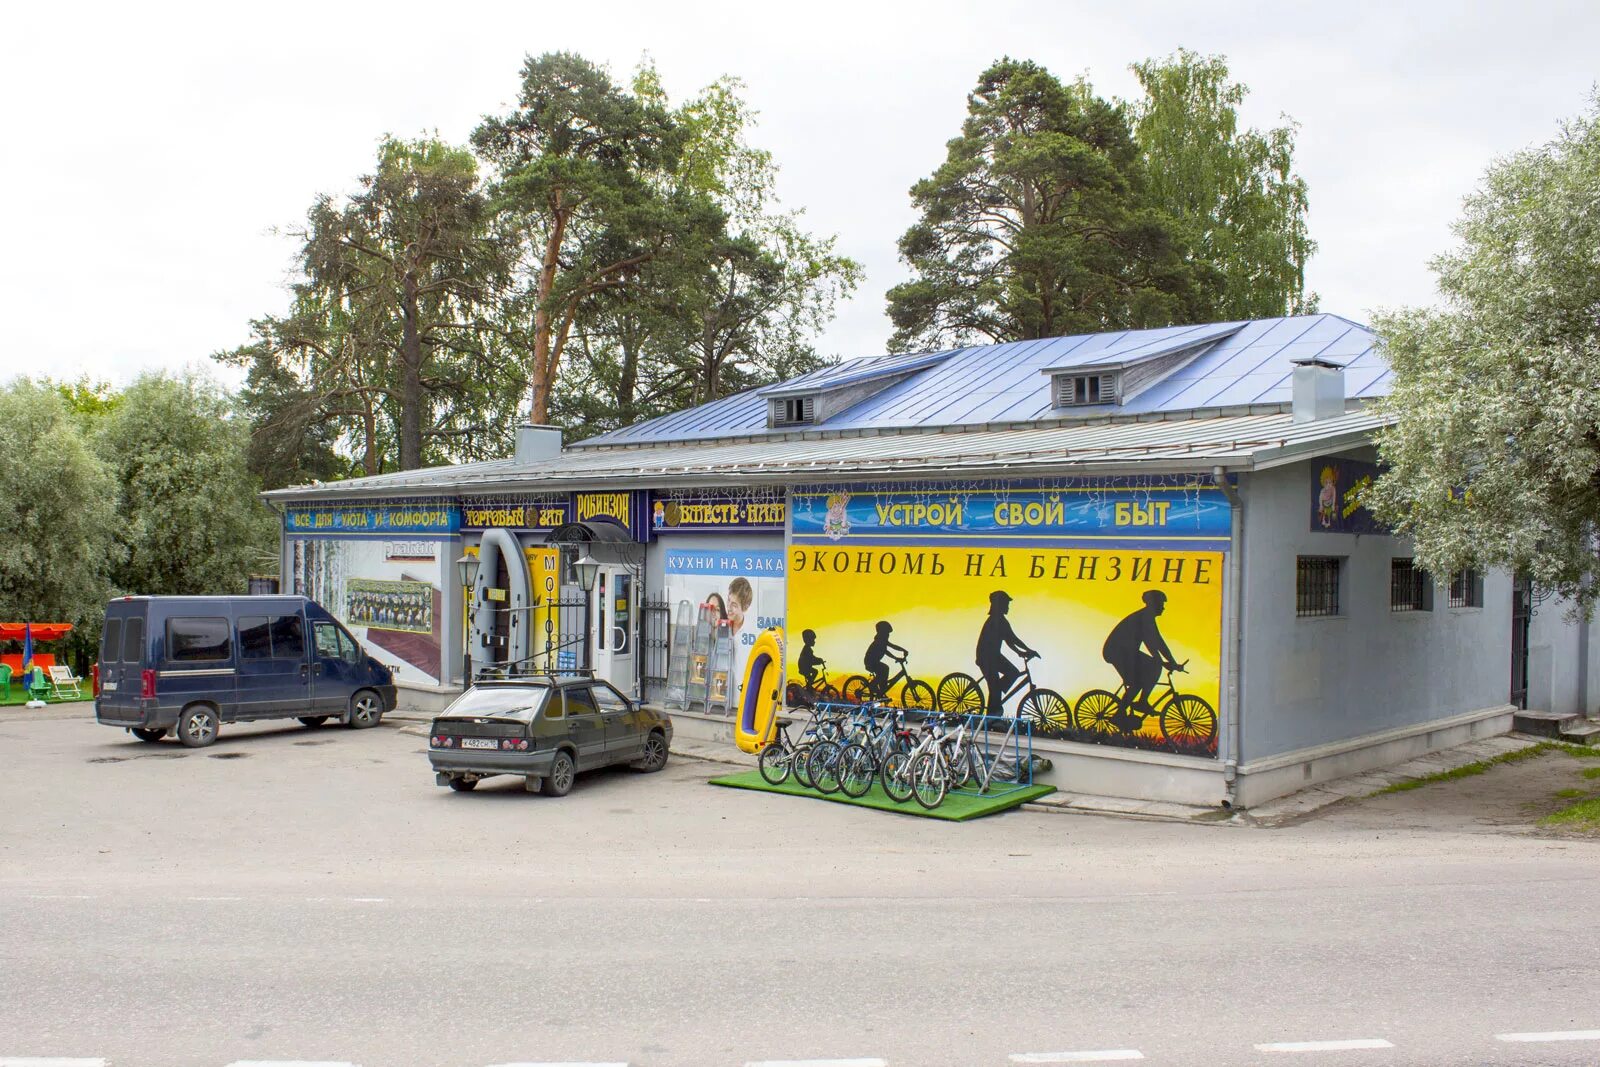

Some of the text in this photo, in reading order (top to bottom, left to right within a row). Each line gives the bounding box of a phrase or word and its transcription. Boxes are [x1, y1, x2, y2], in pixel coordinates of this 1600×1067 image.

[295, 511, 448, 528] ВСЕ ДЛЯ УЮТА И КОМФОРТА
[466, 507, 565, 526] ТОРГОВЫЙ ЗАЛ
[577, 493, 630, 529] РОБИНЗОН
[679, 504, 739, 523] ВМЕСТЕ
[876, 495, 1170, 527] УСТРОЙ СВОЙ БЫТ
[669, 557, 714, 569] КУХНИ
[720, 558, 738, 570] НА
[793, 550, 1212, 584] ЭКОНОМЬ НА БЕНЗИНЕ
